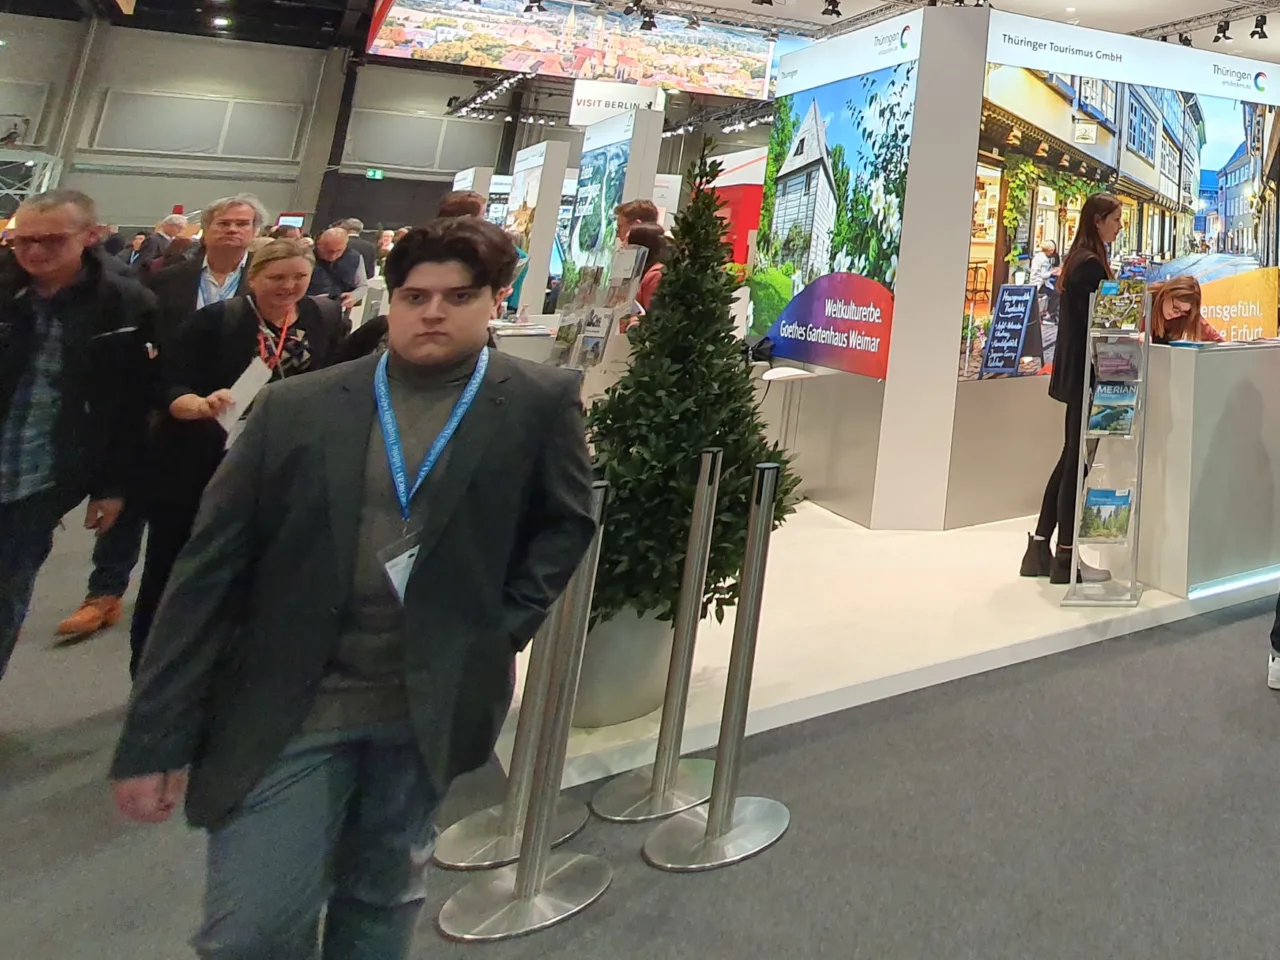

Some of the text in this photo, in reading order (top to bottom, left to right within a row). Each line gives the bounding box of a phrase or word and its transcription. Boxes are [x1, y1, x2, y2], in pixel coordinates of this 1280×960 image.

[1001, 33, 1123, 63] Thüringer Tourismus GmbH
[1212, 63, 1252, 82] Thüringen
[575, 98, 640, 111] VISIT BERLIN
[825, 298, 882, 323] Weltkulturerbe.
[1200, 300, 1263, 321] ensgefühl.
[779, 320, 881, 352] Goethes Gartenhaus Weimar
[1231, 324, 1263, 341] Erfurt
[1097, 385, 1138, 395] MERIAN
